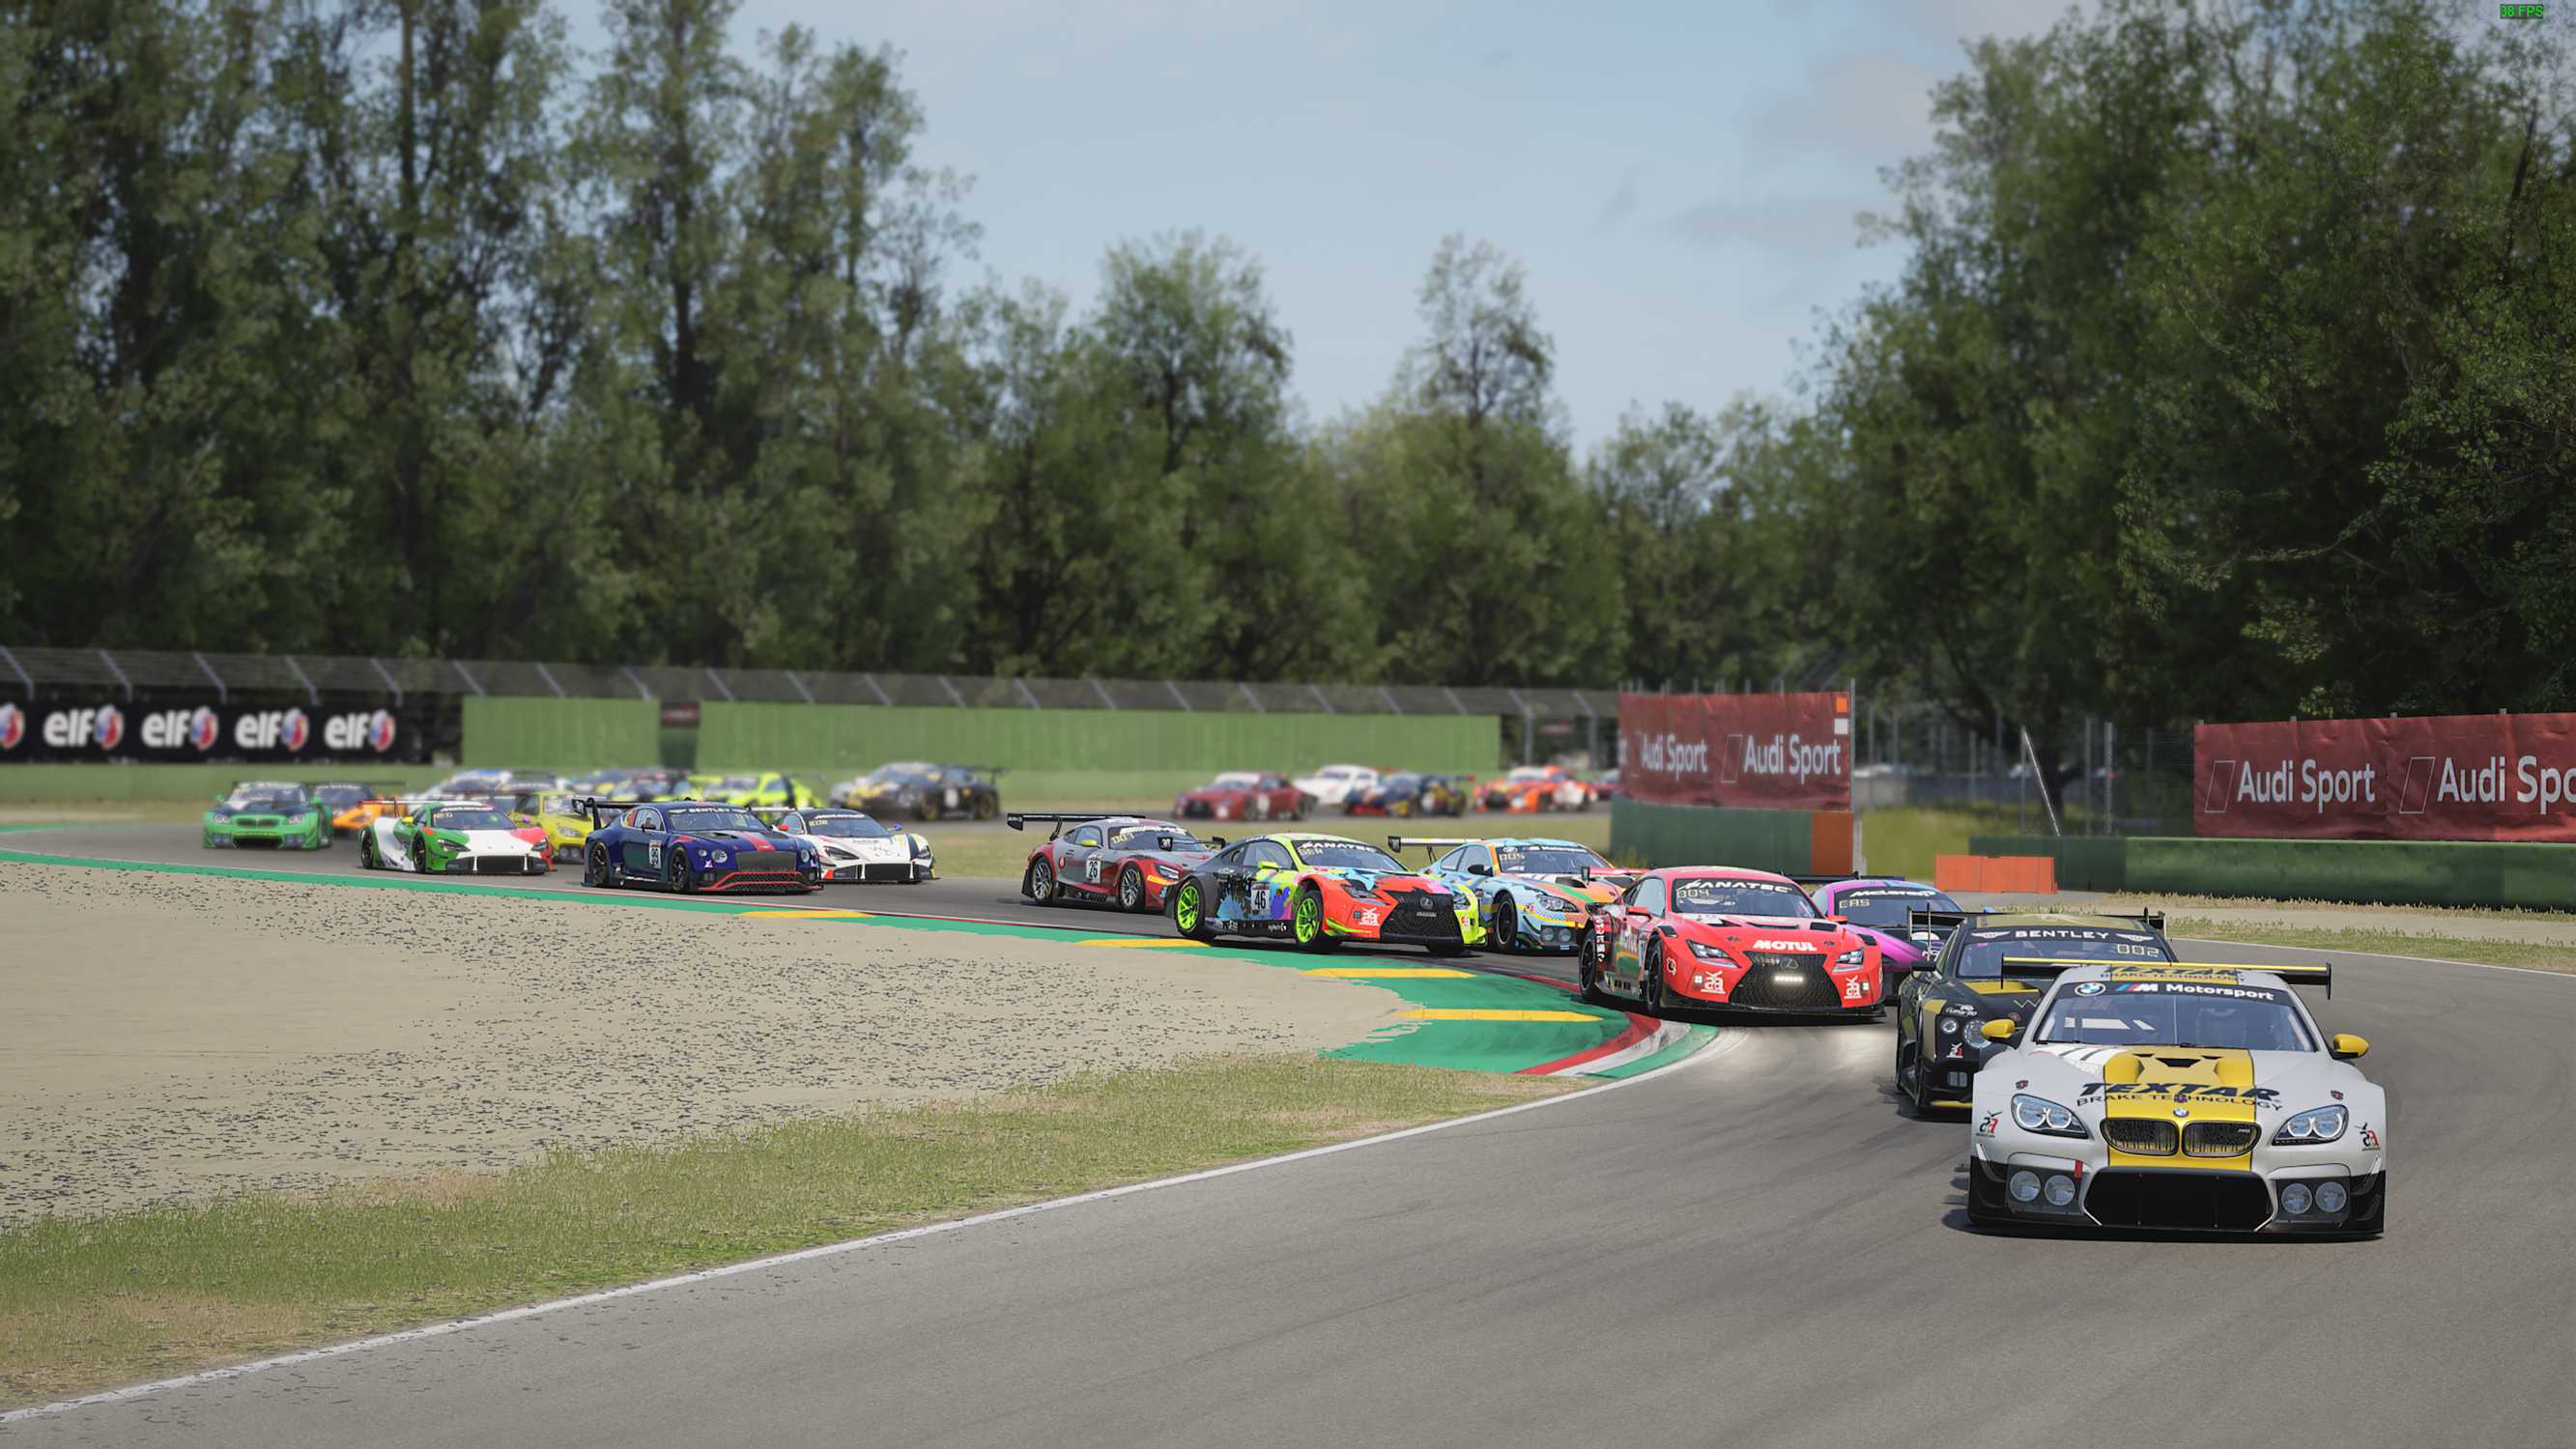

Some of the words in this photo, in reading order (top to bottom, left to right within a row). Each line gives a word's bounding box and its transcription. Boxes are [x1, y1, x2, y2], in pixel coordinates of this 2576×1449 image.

[43, 708, 95, 747] elf
[141, 709, 190, 747] elf
[235, 712, 282, 748] elf
[324, 713, 370, 749] elf
[1642, 734, 1664, 772] Audi
[1667, 733, 1707, 781] Sport
[1744, 734, 1784, 774] Audi
[1789, 734, 1841, 784] Sport
[2237, 759, 2294, 803] Audi
[2302, 758, 2376, 813] Sport
[2437, 755, 2505, 803] Audi
[2516, 755, 2576, 814] Spo
[1254, 891, 1267, 909] 46
[1677, 879, 1792, 893] FANATEC
[1753, 940, 1817, 952] MOTUL
[2015, 930, 2109, 940] BENTLEY
[2165, 983, 2275, 1001] Motorsport
[2076, 1094, 2142, 1107] BRAKE
[2150, 1094, 2284, 1111] TEHNOLOGY
[2080, 1082, 2280, 1101] TEXTAR
